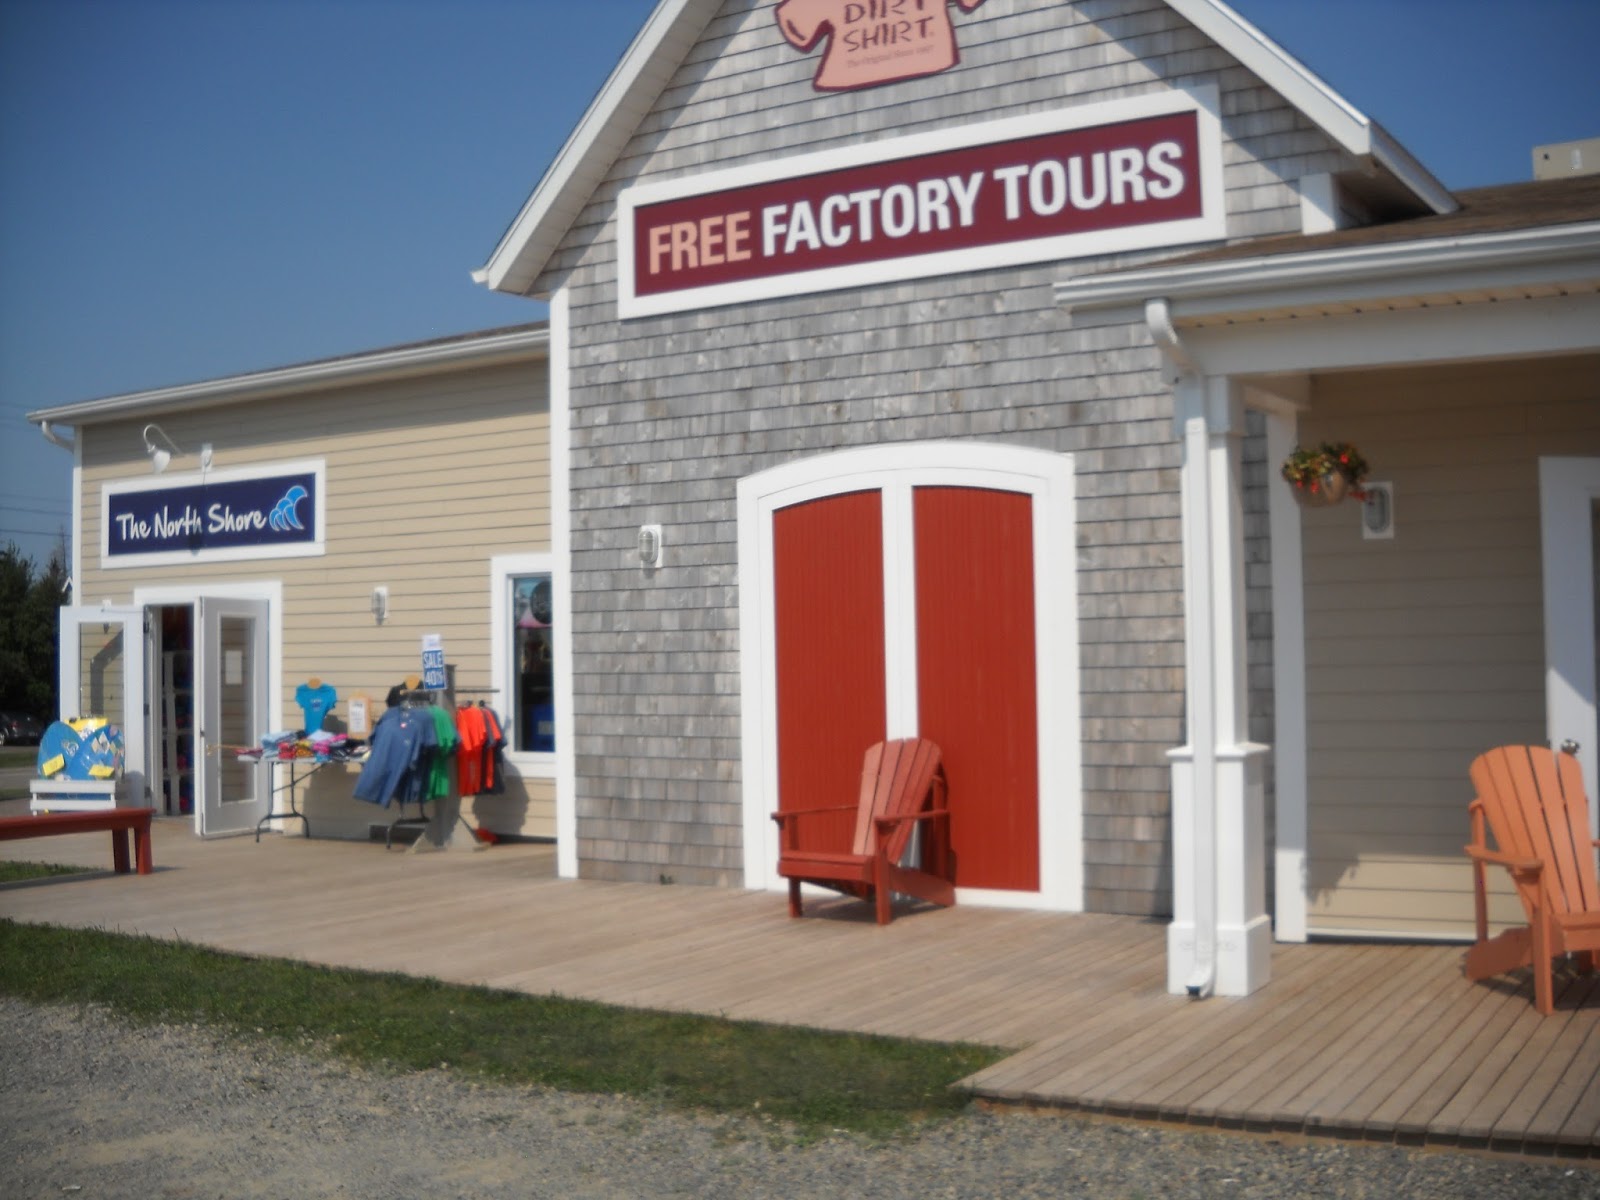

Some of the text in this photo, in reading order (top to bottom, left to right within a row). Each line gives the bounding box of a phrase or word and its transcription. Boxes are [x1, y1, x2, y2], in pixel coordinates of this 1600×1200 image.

[844, 17, 933, 52] SHIRT
[648, 142, 1185, 275] FREE FACTORY TOURS
[116, 503, 267, 541] The North Shore
[424, 652, 443, 669] SALE
